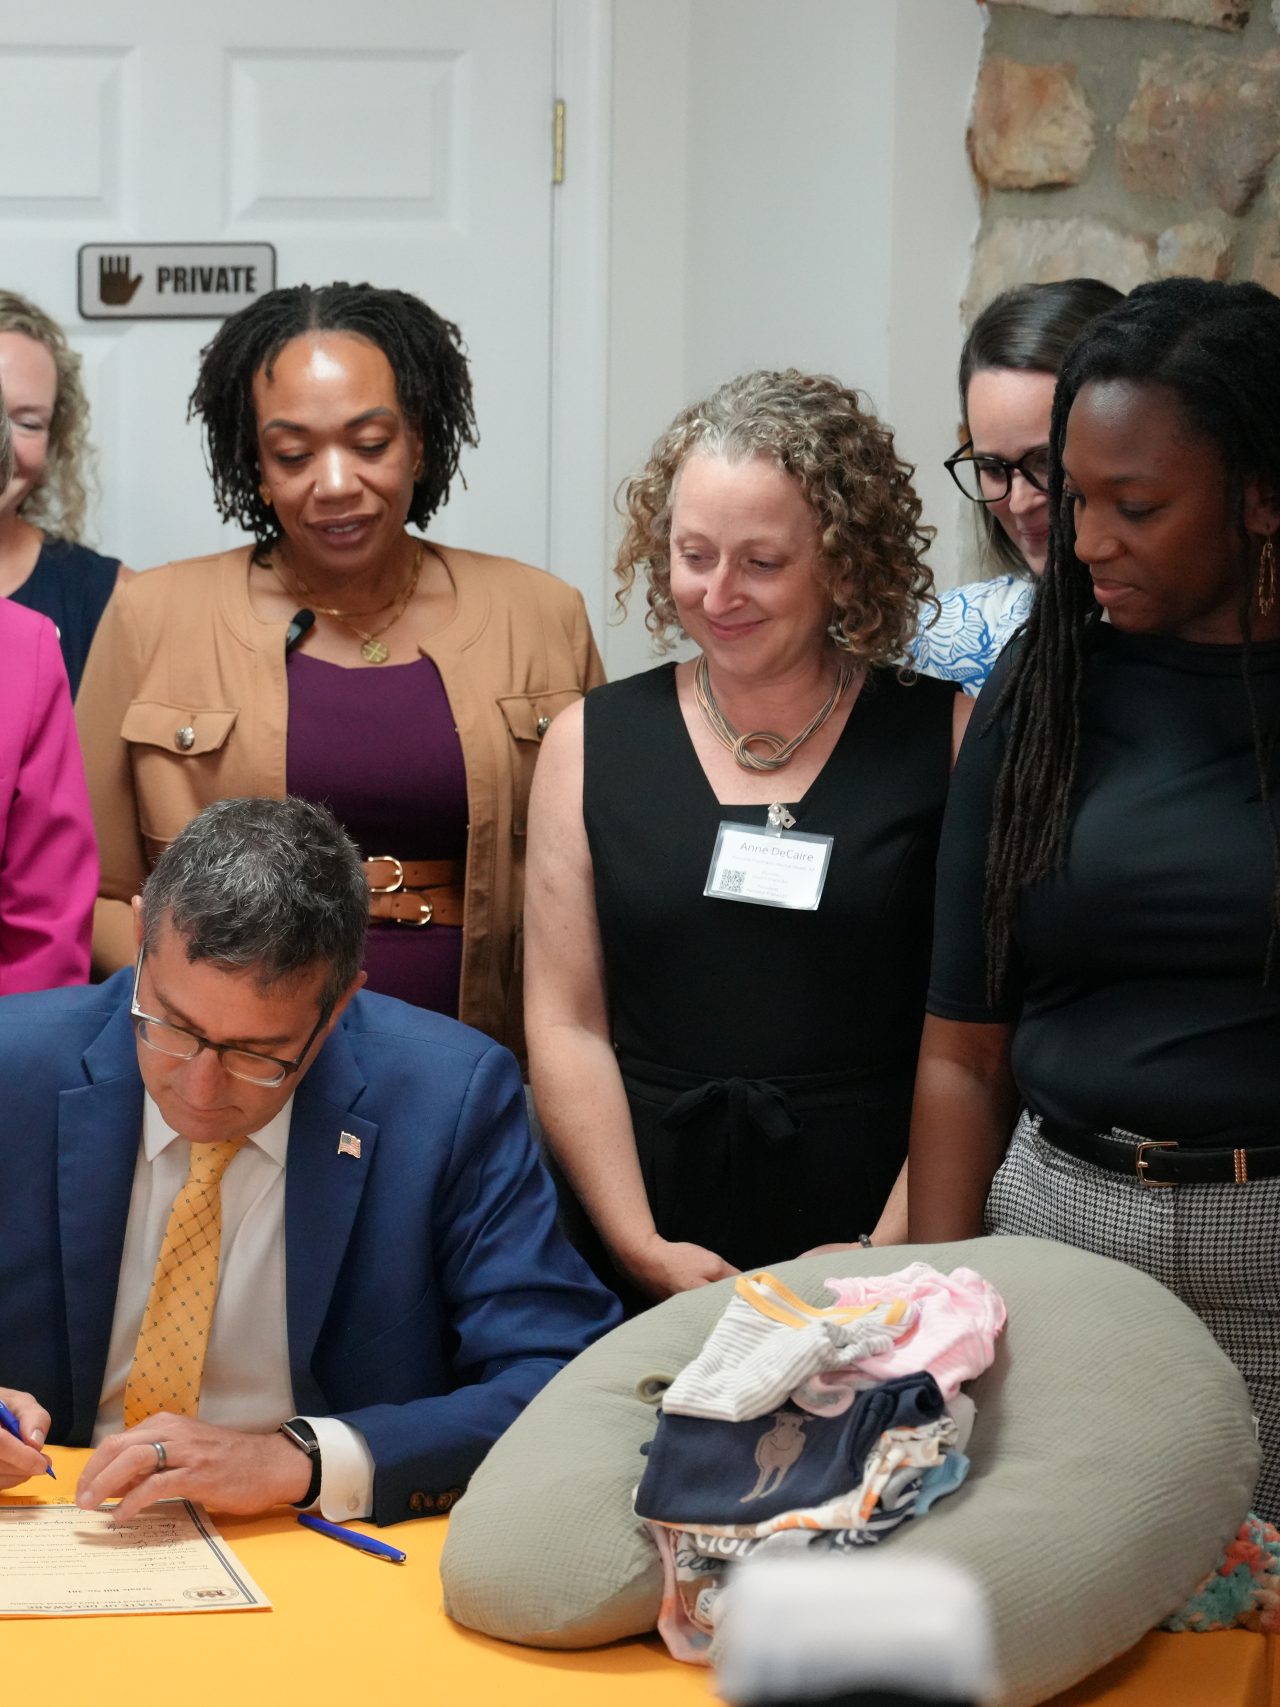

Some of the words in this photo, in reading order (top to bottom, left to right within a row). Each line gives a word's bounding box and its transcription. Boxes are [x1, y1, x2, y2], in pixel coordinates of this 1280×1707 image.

[157, 266, 256, 294] PRIVATE
[740, 842, 769, 855] Anne
[771, 847, 814, 861] DeCaire
